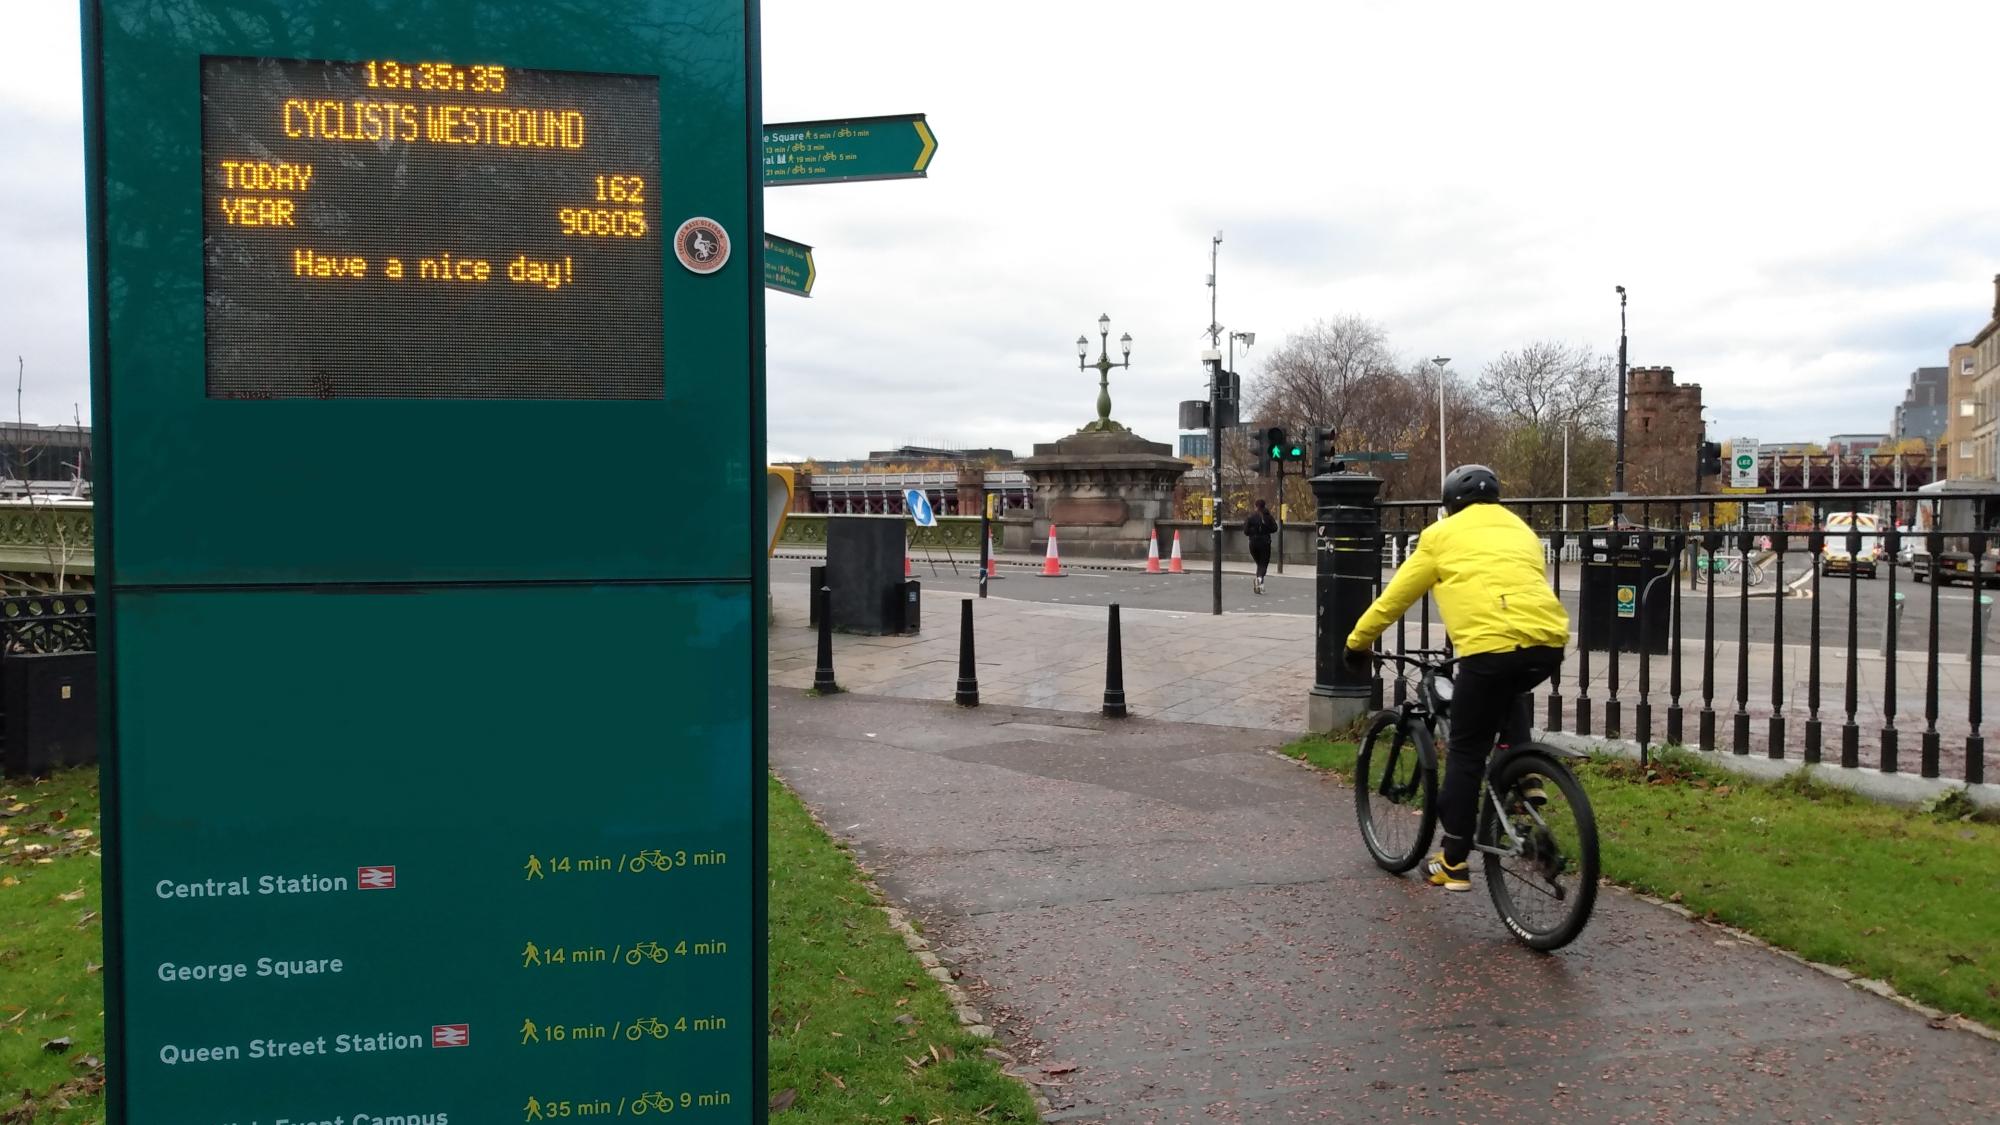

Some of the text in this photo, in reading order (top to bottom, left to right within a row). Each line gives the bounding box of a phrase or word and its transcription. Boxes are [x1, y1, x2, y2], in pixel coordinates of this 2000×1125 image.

[366, 61, 506, 93] 13:35:35
[283, 98, 584, 150] CYCLISTS WESTBOUND
[772, 132, 805, 144] Square
[857, 129, 870, 137] min
[775, 145, 786, 154] min
[846, 152, 857, 160] min
[220, 159, 313, 193] TODAY
[774, 168, 786, 176] min
[595, 174, 645, 205] 162
[220, 196, 296, 228] YEAR
[558, 207, 646, 238] 90605
[293, 248, 573, 289] Have a nice day!
[550, 849, 726, 873] 14 min / 3 min
[156, 873, 348, 899] Central Station
[544, 939, 726, 964] 14 min / 4 min
[157, 955, 343, 984] George Square
[545, 1015, 726, 1041] 16 min / 4 min
[159, 1031, 423, 1065] Queen Street Station
[546, 1090, 730, 1118] 35 min / 9 min
